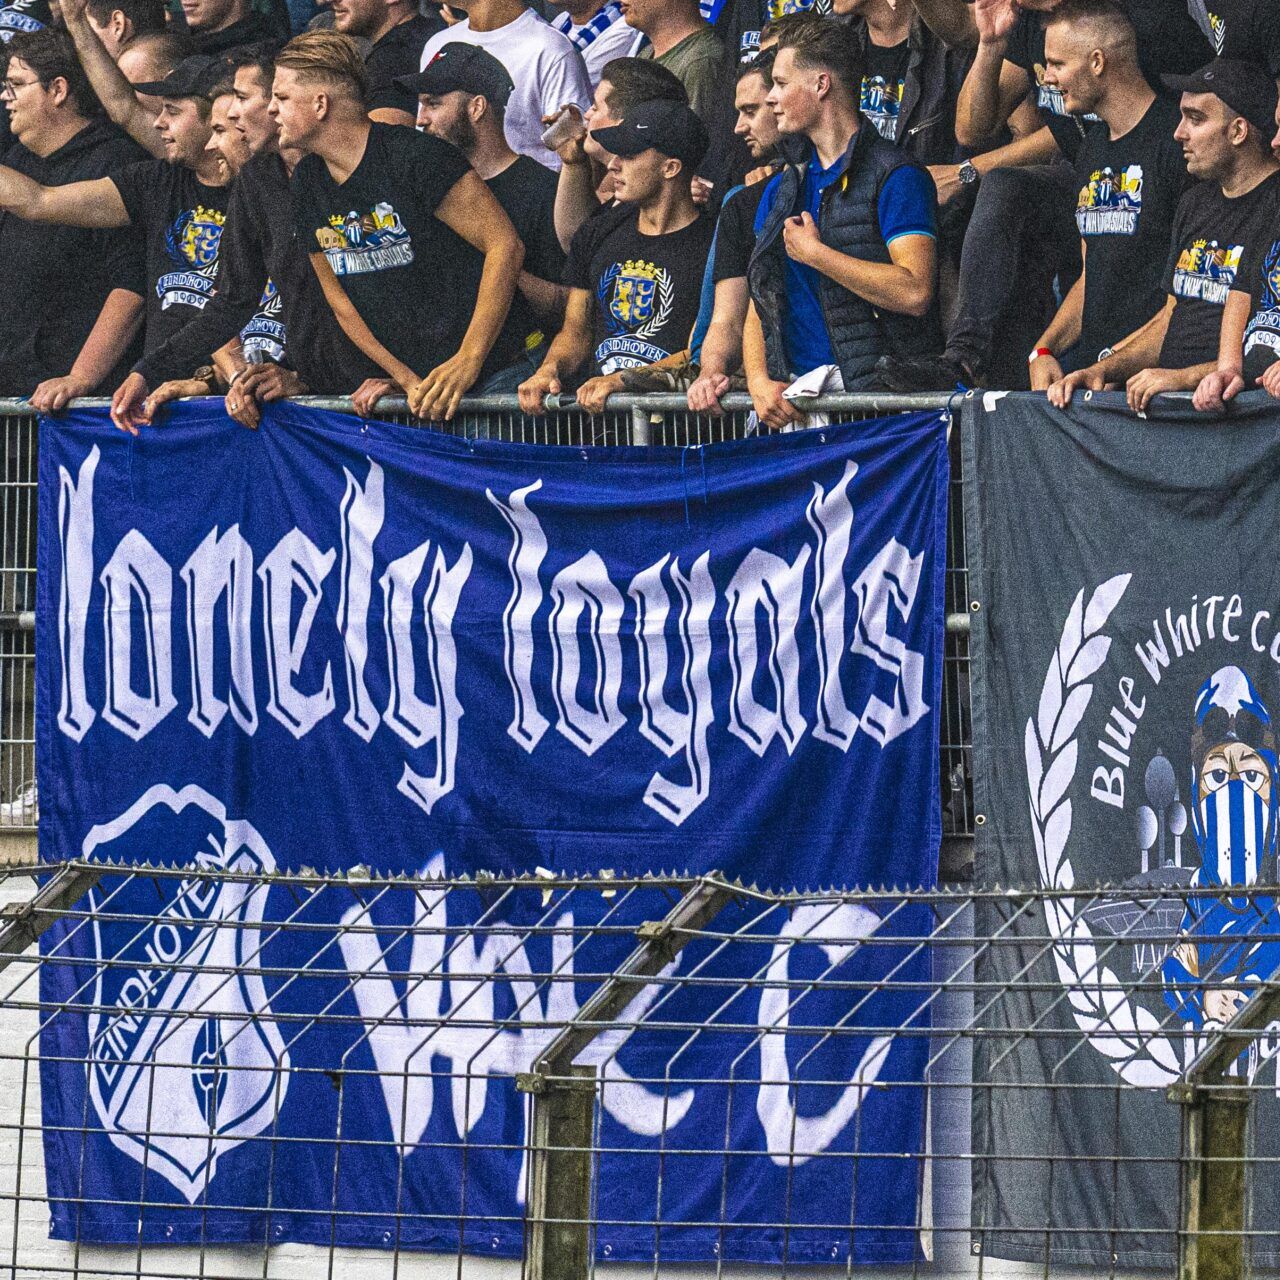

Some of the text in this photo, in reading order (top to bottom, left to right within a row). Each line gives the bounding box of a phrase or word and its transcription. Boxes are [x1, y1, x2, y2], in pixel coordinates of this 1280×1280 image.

[58, 442, 931, 826] lonely loyals
[97, 833, 226, 1087] EINDHOVEN
